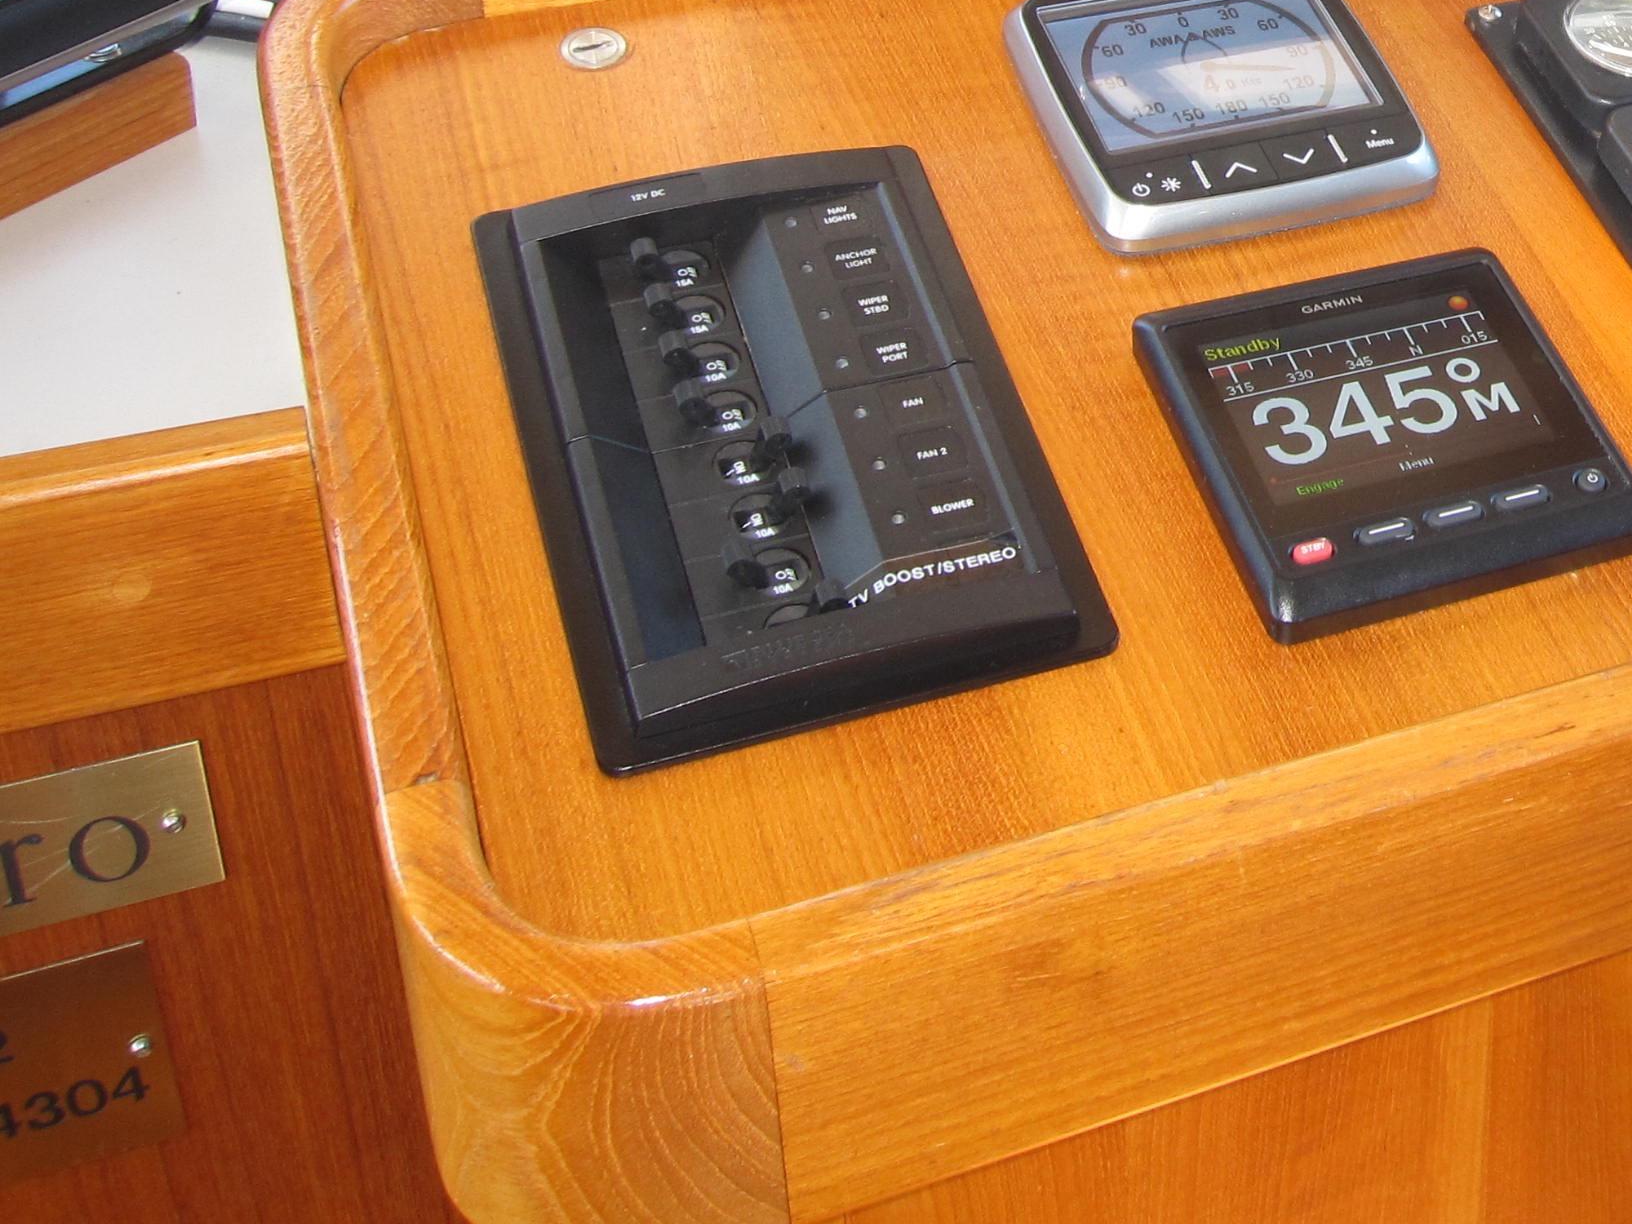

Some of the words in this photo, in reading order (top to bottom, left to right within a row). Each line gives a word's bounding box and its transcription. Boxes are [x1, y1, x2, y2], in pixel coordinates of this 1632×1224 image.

[1177, 15, 1190, 28] 0
[1216, 7, 1240, 22] 30
[1124, 22, 1148, 37] 30
[1256, 17, 1280, 32] 60
[1150, 33, 1183, 49] AWA
[1202, 24, 1237, 40] AWS
[1101, 43, 1125, 58] 60
[1215, 98, 1249, 115] 180
[1258, 91, 1291, 108] 150
[1133, 101, 1166, 119] 120
[1172, 107, 1206, 124] 150
[1365, 135, 1395, 149] Menu
[630, 192, 649, 202] 12V
[650, 188, 667, 198] DC
[827, 205, 847, 215] NAV
[823, 212, 858, 224] LIGHTS
[834, 247, 878, 262] ANCHOR
[844, 257, 873, 269] LIGHT
[858, 294, 889, 306] WIPER
[1301, 294, 1364, 315] GARMIN
[863, 304, 890, 316] STBD
[1461, 331, 1489, 346] 015
[875, 342, 908, 355] WIPER
[1203, 336, 1282, 362] Standby
[1408, 345, 1424, 357] N
[881, 351, 909, 364] PORT
[1345, 355, 1374, 371] 345
[1285, 368, 1315, 384] 330
[1225, 381, 1256, 397] 315
[902, 396, 924, 409] FAN
[916, 448, 938, 461] FAN
[940, 447, 949, 456] 2
[1398, 455, 1435, 472] Menu
[1295, 477, 1345, 496] Engage
[930, 497, 975, 516] BLOWER
[1300, 541, 1326, 555] STBY
[847, 588, 869, 609] TV
[872, 546, 1018, 595] BOOST/STEREO
